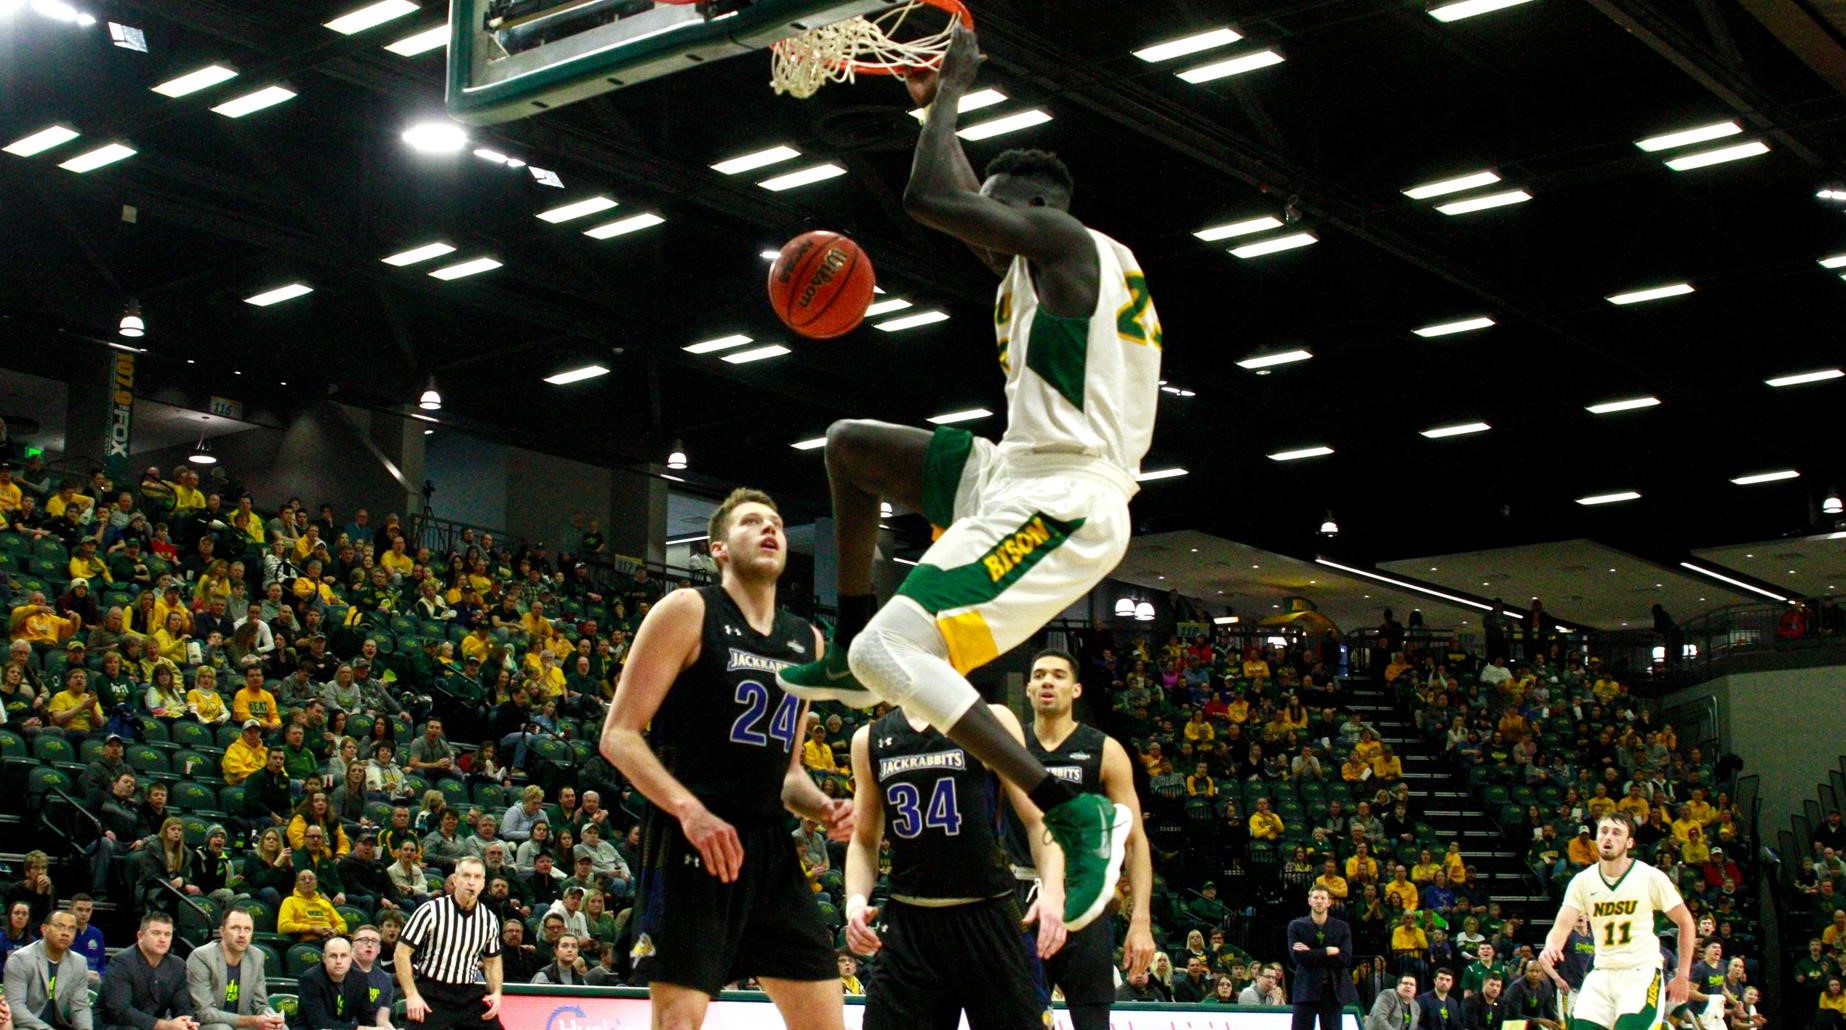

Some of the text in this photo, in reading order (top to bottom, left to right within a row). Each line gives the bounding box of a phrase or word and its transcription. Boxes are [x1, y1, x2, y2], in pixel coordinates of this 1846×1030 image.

[797, 248, 848, 309] Wilson
[1115, 270, 1162, 352] 2
[114, 352, 135, 406] 107.9
[111, 408, 129, 458] FOX
[213, 401, 233, 417] 116
[983, 516, 1050, 583] BISON
[730, 680, 800, 753] 24
[881, 751, 964, 778] JACKRABBITS
[887, 777, 962, 839] 34
[1593, 900, 1638, 917] NDSU
[1604, 921, 1632, 946] 11
